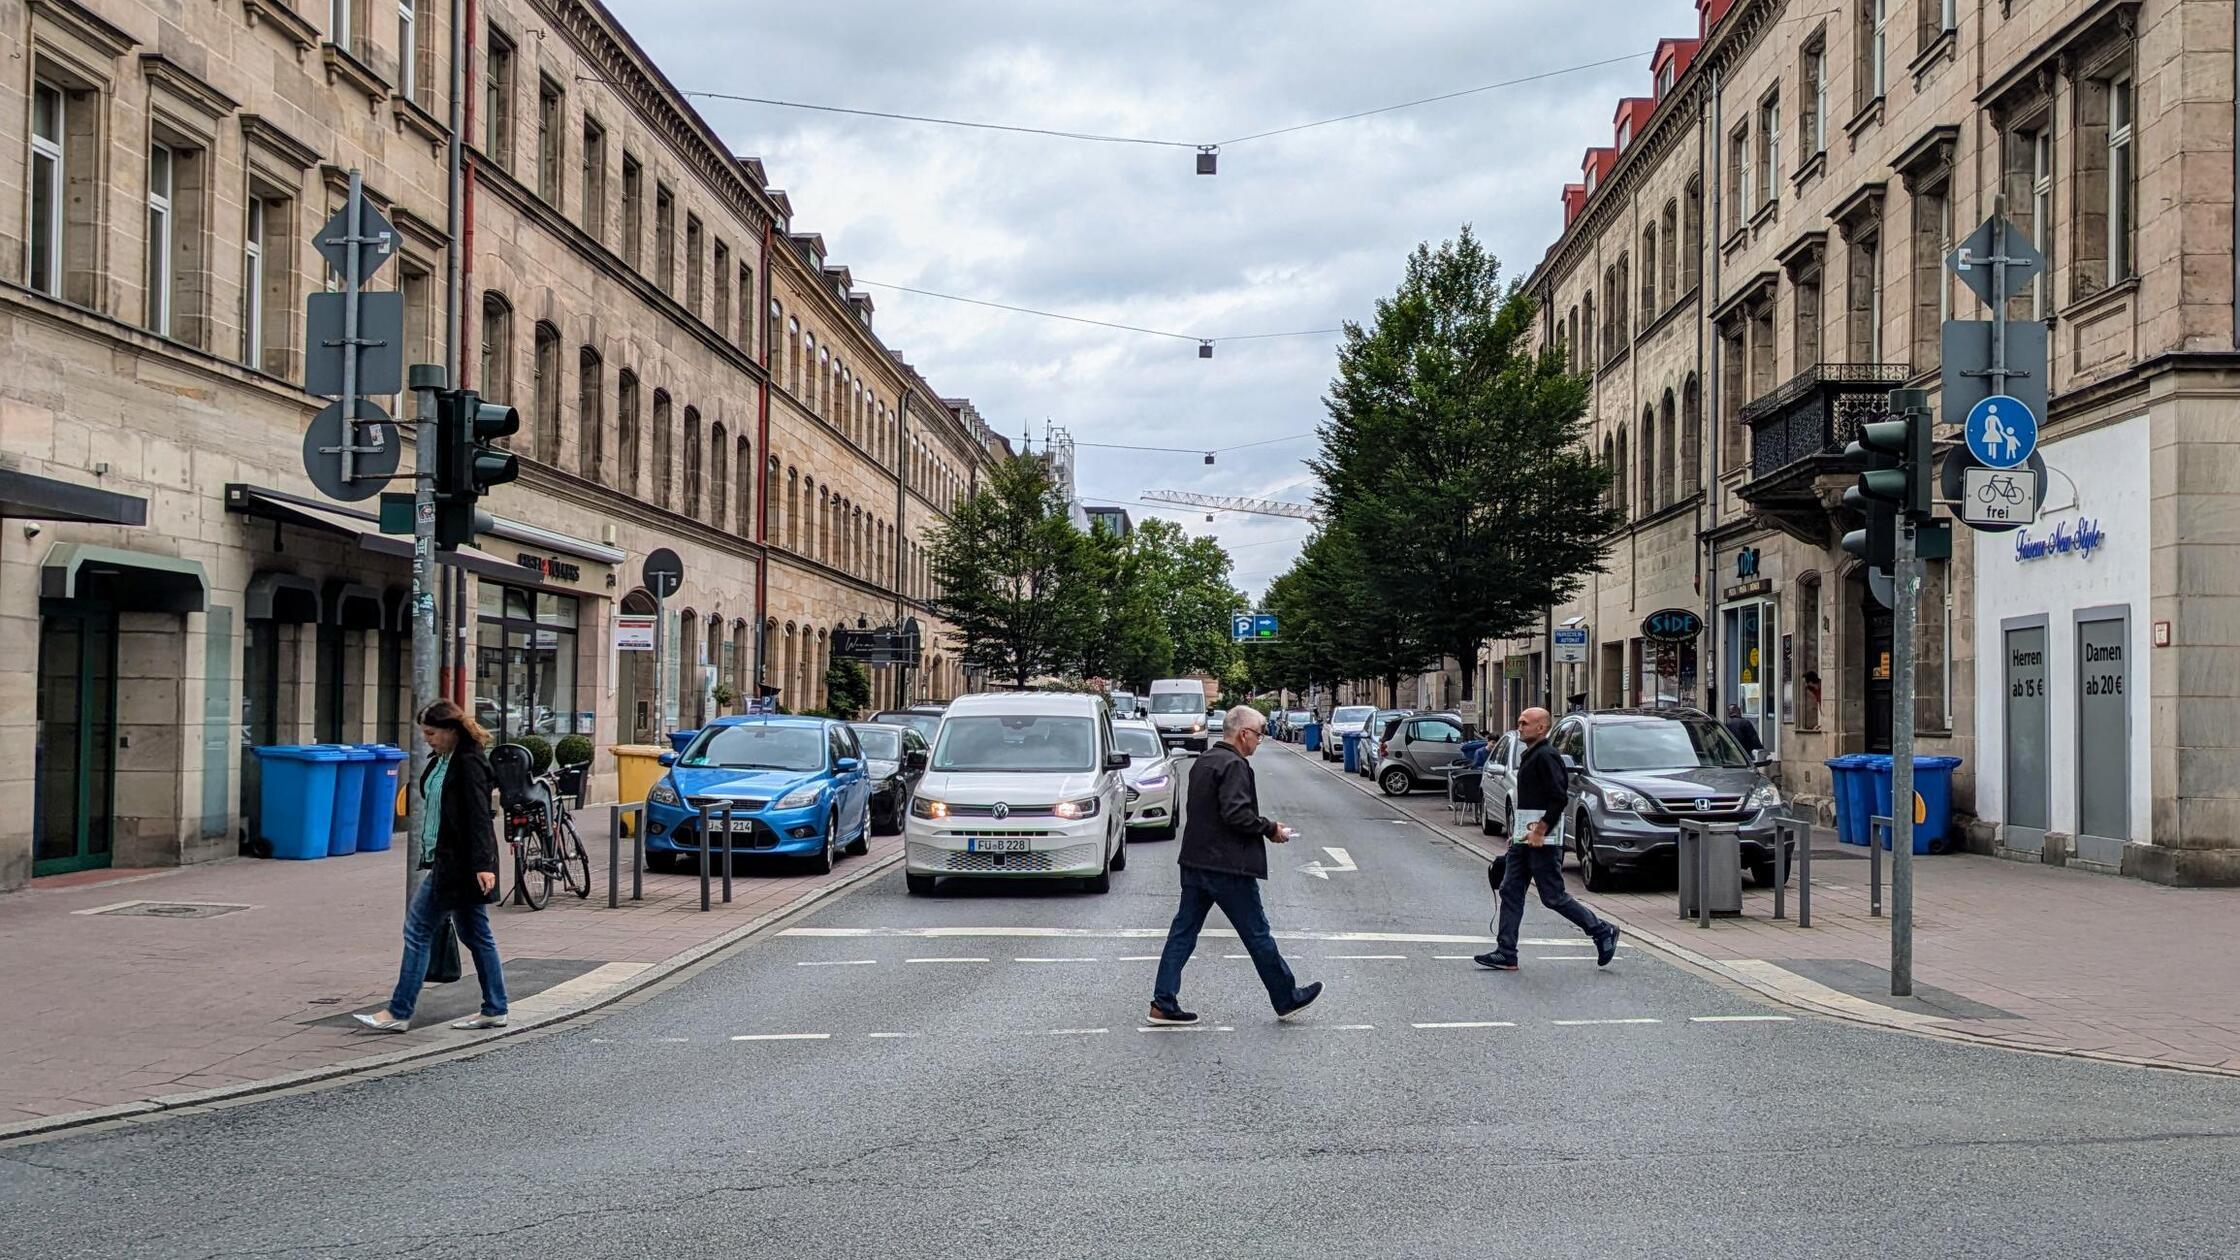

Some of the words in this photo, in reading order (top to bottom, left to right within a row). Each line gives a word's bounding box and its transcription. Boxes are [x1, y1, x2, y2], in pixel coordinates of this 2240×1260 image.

[1986, 505, 2009, 518] frei
[2073, 517, 2101, 560] Style
[2012, 649, 2042, 667] Herren
[2085, 642, 2122, 662] Damen
[2012, 678, 2024, 697] ab
[2025, 679, 2034, 697] 15
[2037, 678, 2043, 696] €
[2086, 674, 2098, 695] ab
[2100, 674, 2114, 694] 20
[2115, 675, 2122, 694] €
[733, 821, 750, 831] 214
[1006, 840, 1025, 850] 228
